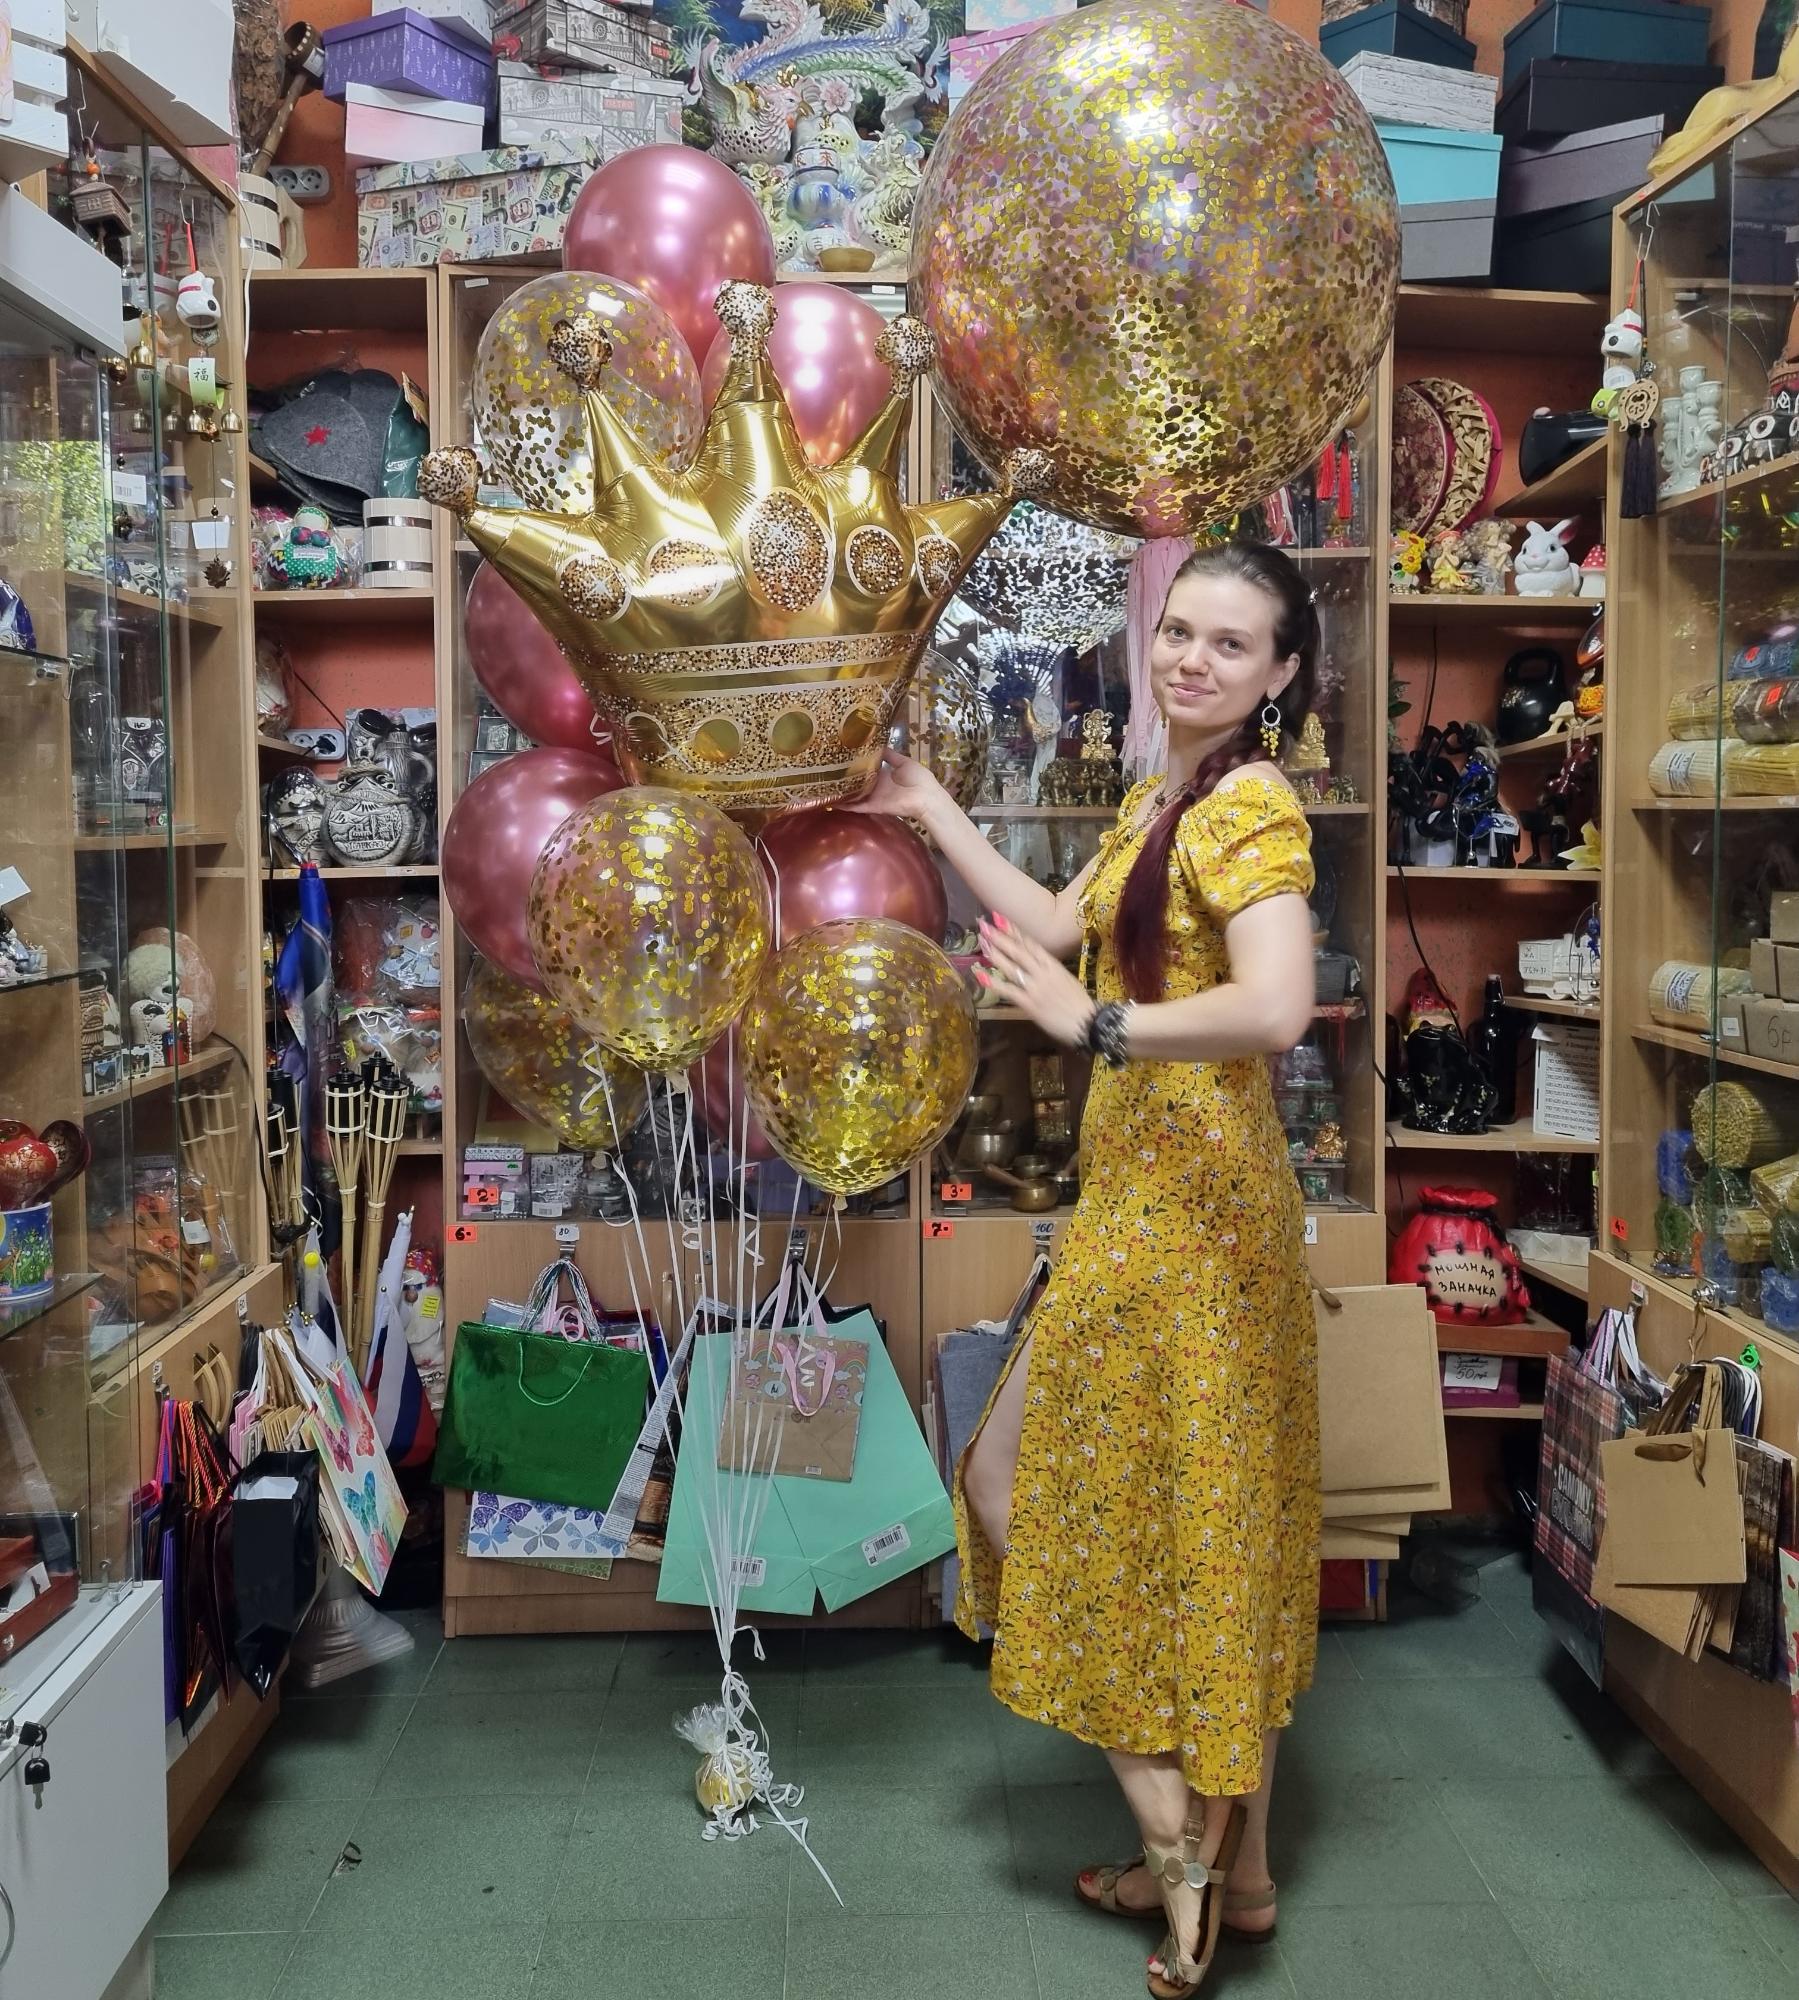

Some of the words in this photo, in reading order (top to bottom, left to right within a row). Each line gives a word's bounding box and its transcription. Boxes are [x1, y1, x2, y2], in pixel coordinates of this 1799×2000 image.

[193, 367, 209, 382] 福
[558, 1228, 569, 1236] 80
[1036, 1222, 1054, 1233] 160
[1438, 1281, 1497, 1298] ЗАНАЧКА
[1456, 1368, 1475, 1380] 50
[770, 1383, 780, 1394] hi
